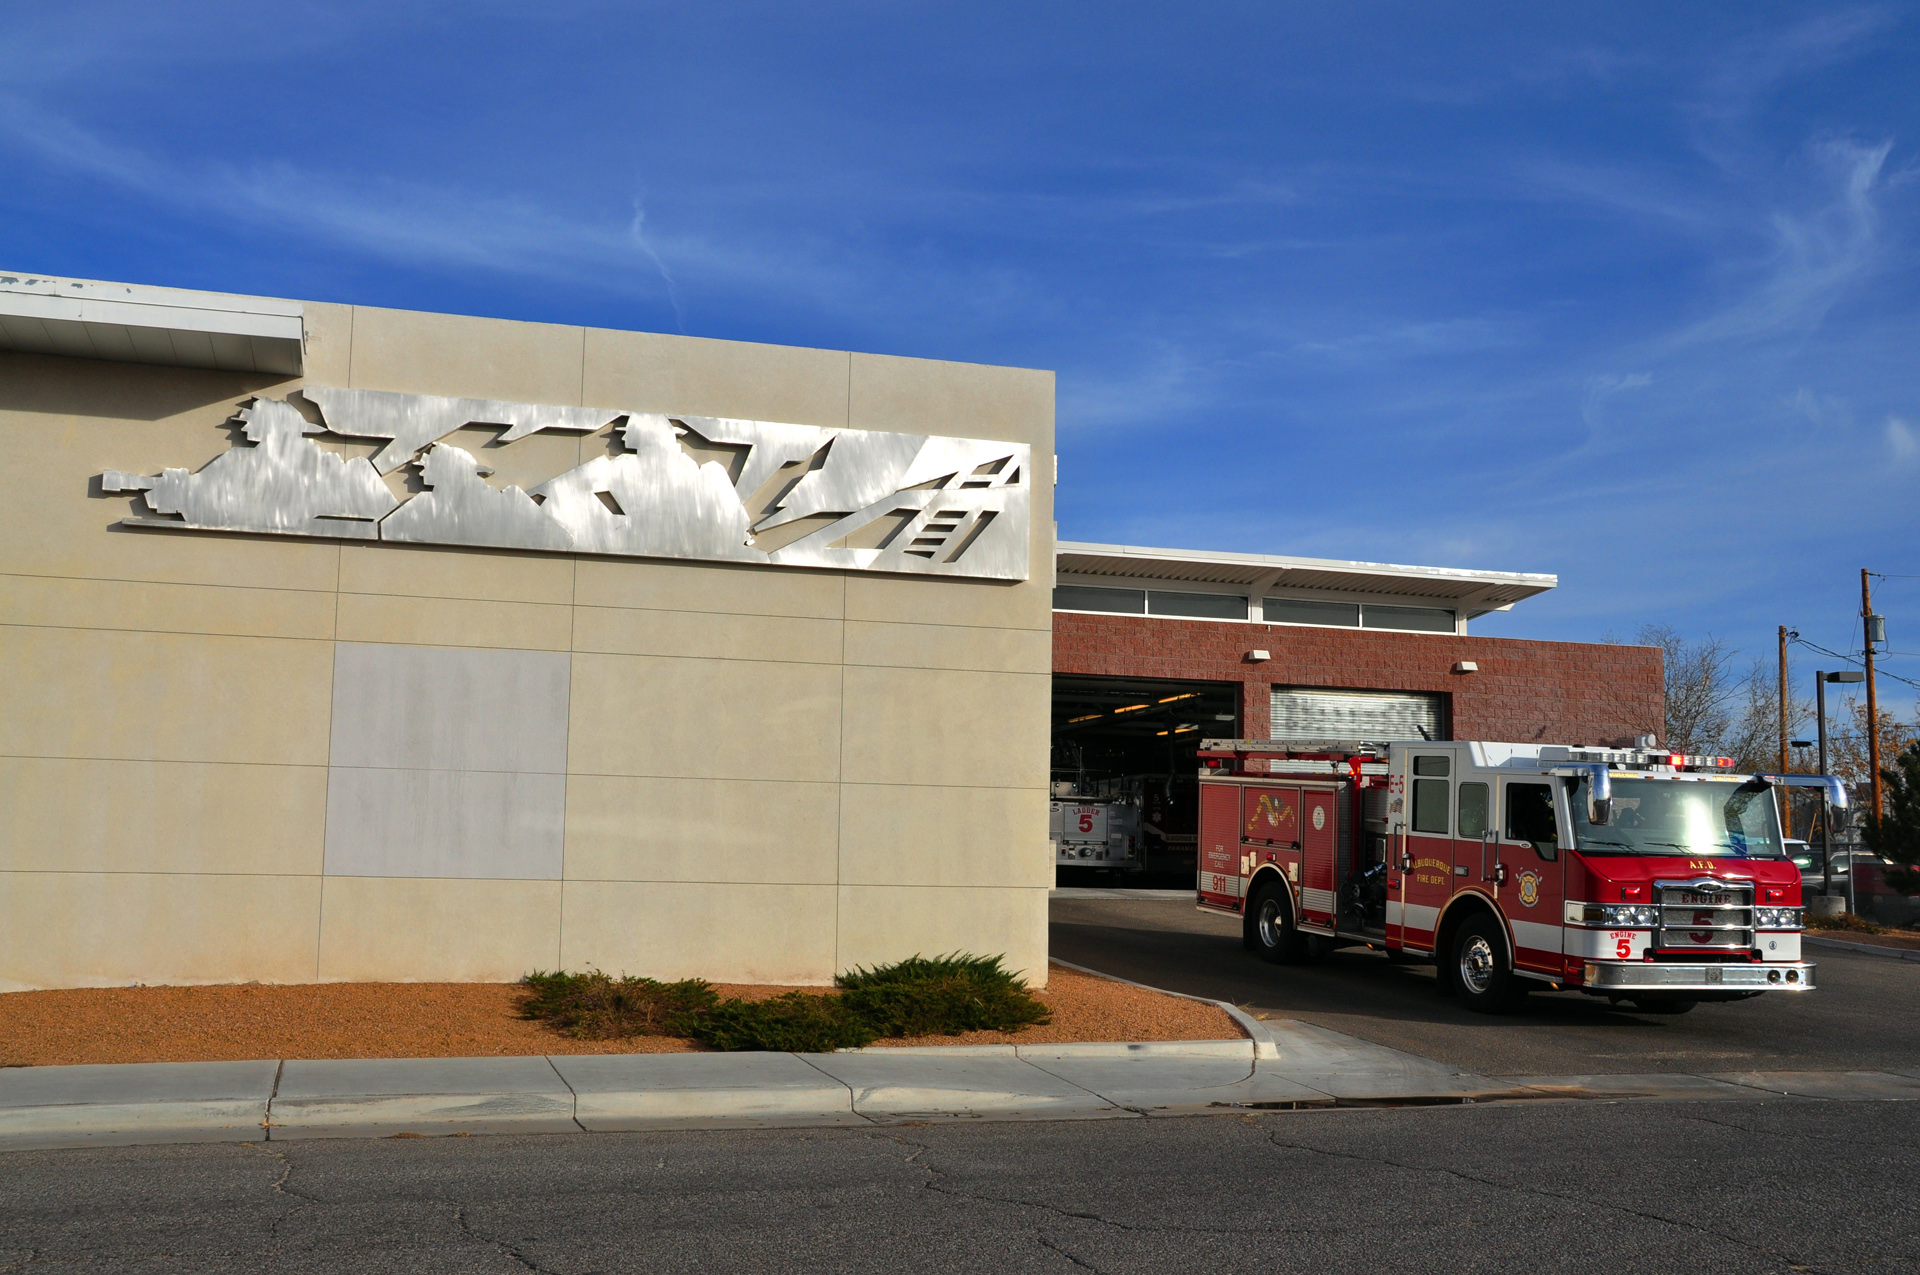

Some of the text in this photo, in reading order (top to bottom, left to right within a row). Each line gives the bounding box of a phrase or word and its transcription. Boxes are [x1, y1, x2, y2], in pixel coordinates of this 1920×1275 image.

[1390, 774, 1404, 794] E-5
[1072, 807, 1100, 816] LADDER
[1078, 814, 1093, 833] 5
[1412, 858, 1451, 874] ALBUQUERQUE
[1690, 860, 1717, 870] A.F.D.
[1212, 875, 1226, 892] 911
[1416, 874, 1445, 886] FIRE DEPT.
[1682, 894, 1731, 904] ENGINE
[1689, 909, 1714, 944] 5
[1610, 931, 1636, 940] ENGINE
[1616, 938, 1631, 958] 5
